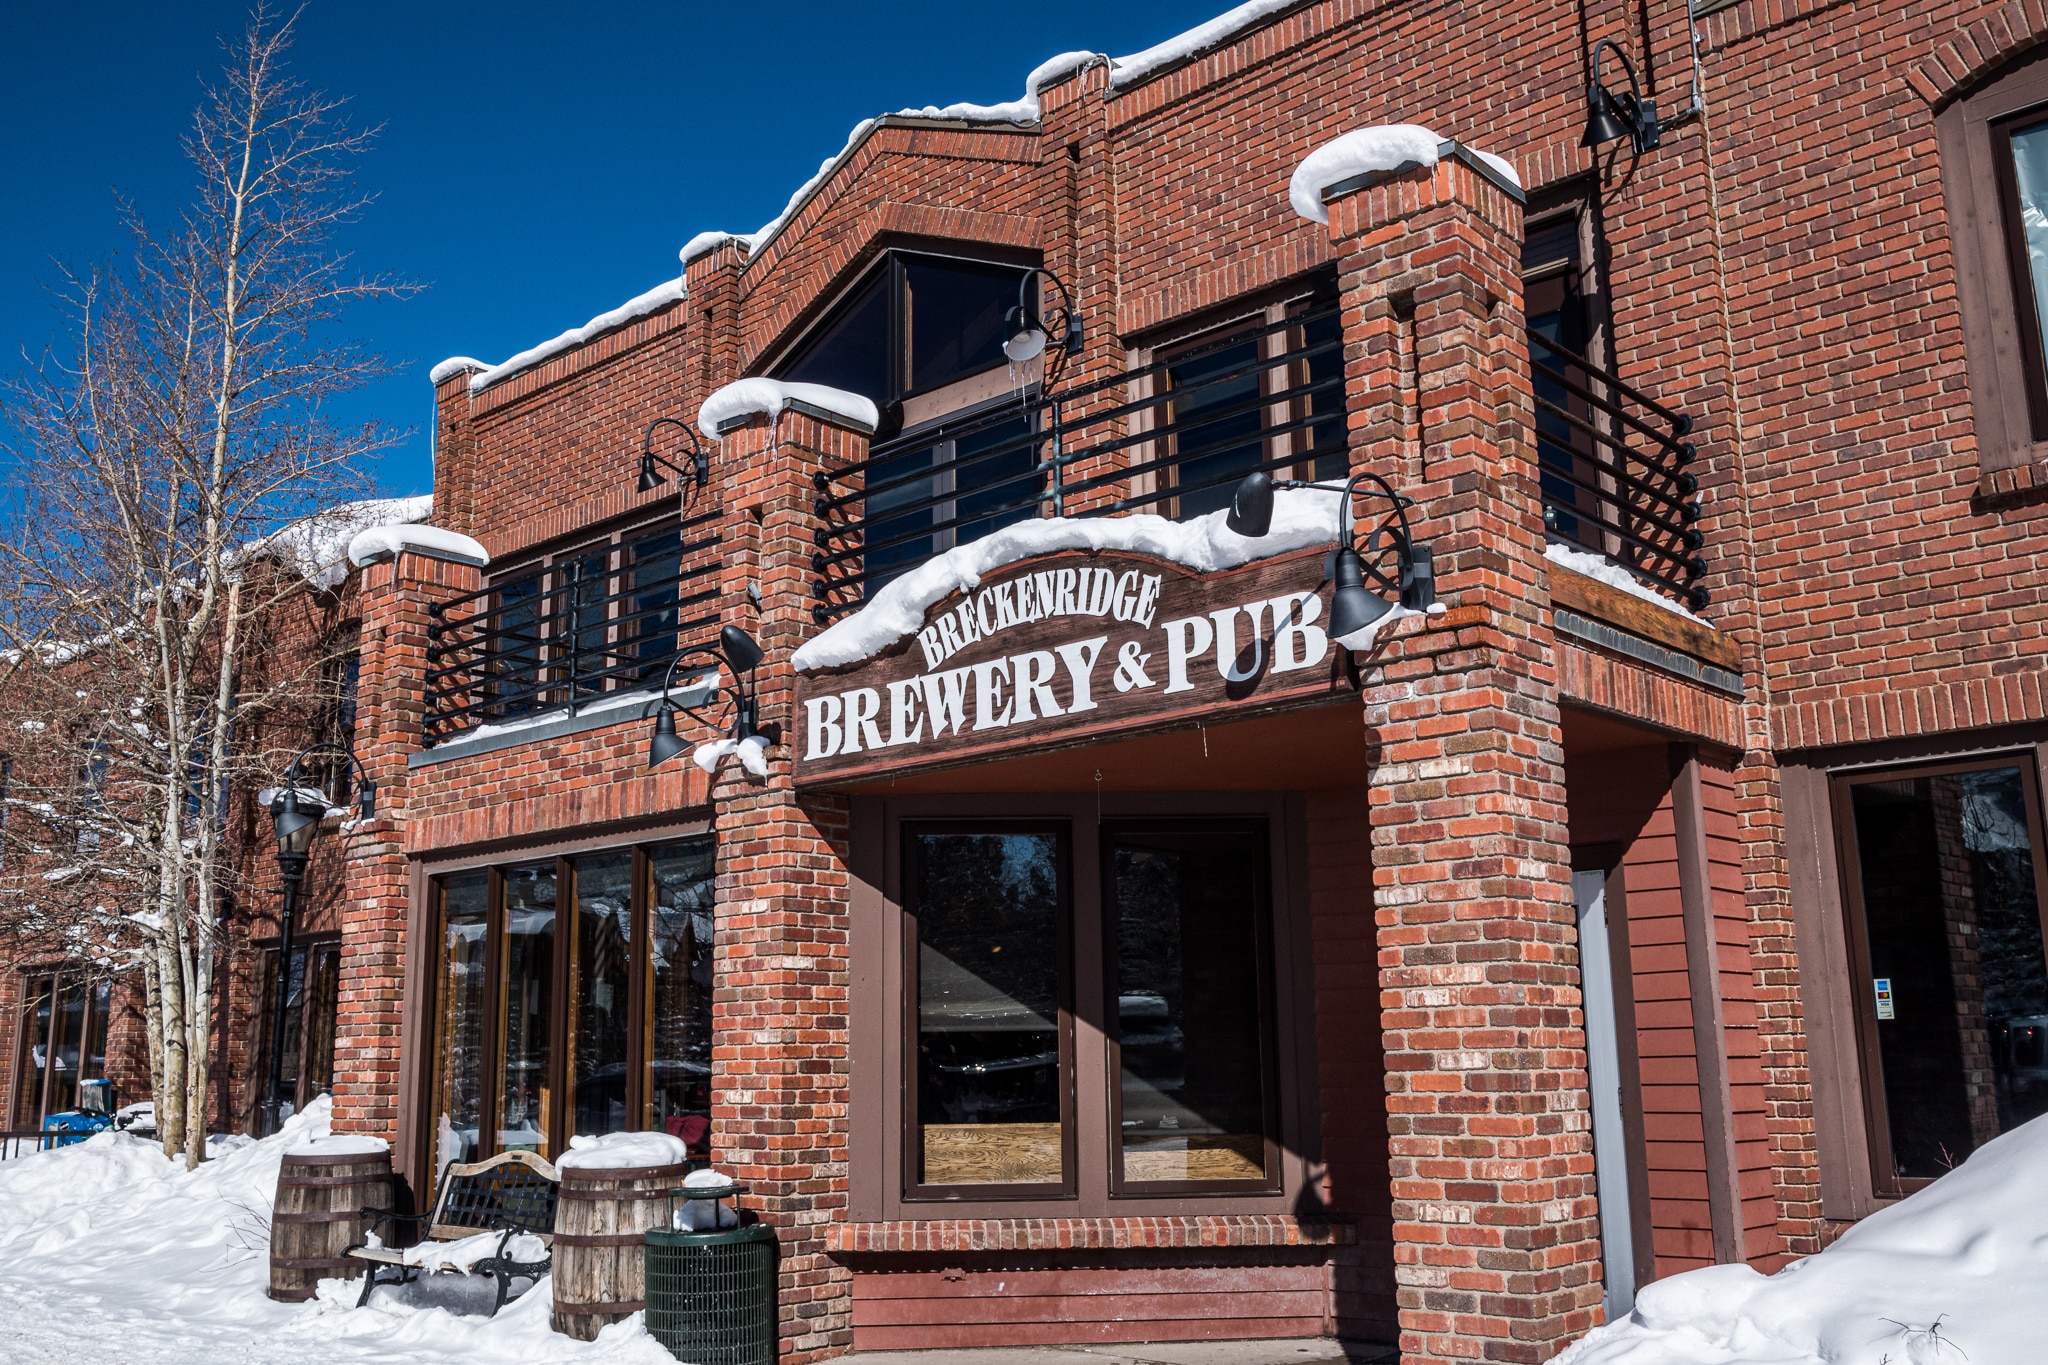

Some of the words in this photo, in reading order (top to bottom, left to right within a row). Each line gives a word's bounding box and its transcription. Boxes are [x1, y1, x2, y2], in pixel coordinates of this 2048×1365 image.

[803, 636, 1108, 761] BREWERY
[1112, 641, 1156, 693] &
[1161, 591, 1328, 694] PUB
[917, 567, 1162, 672] BRECKENRIDGE
